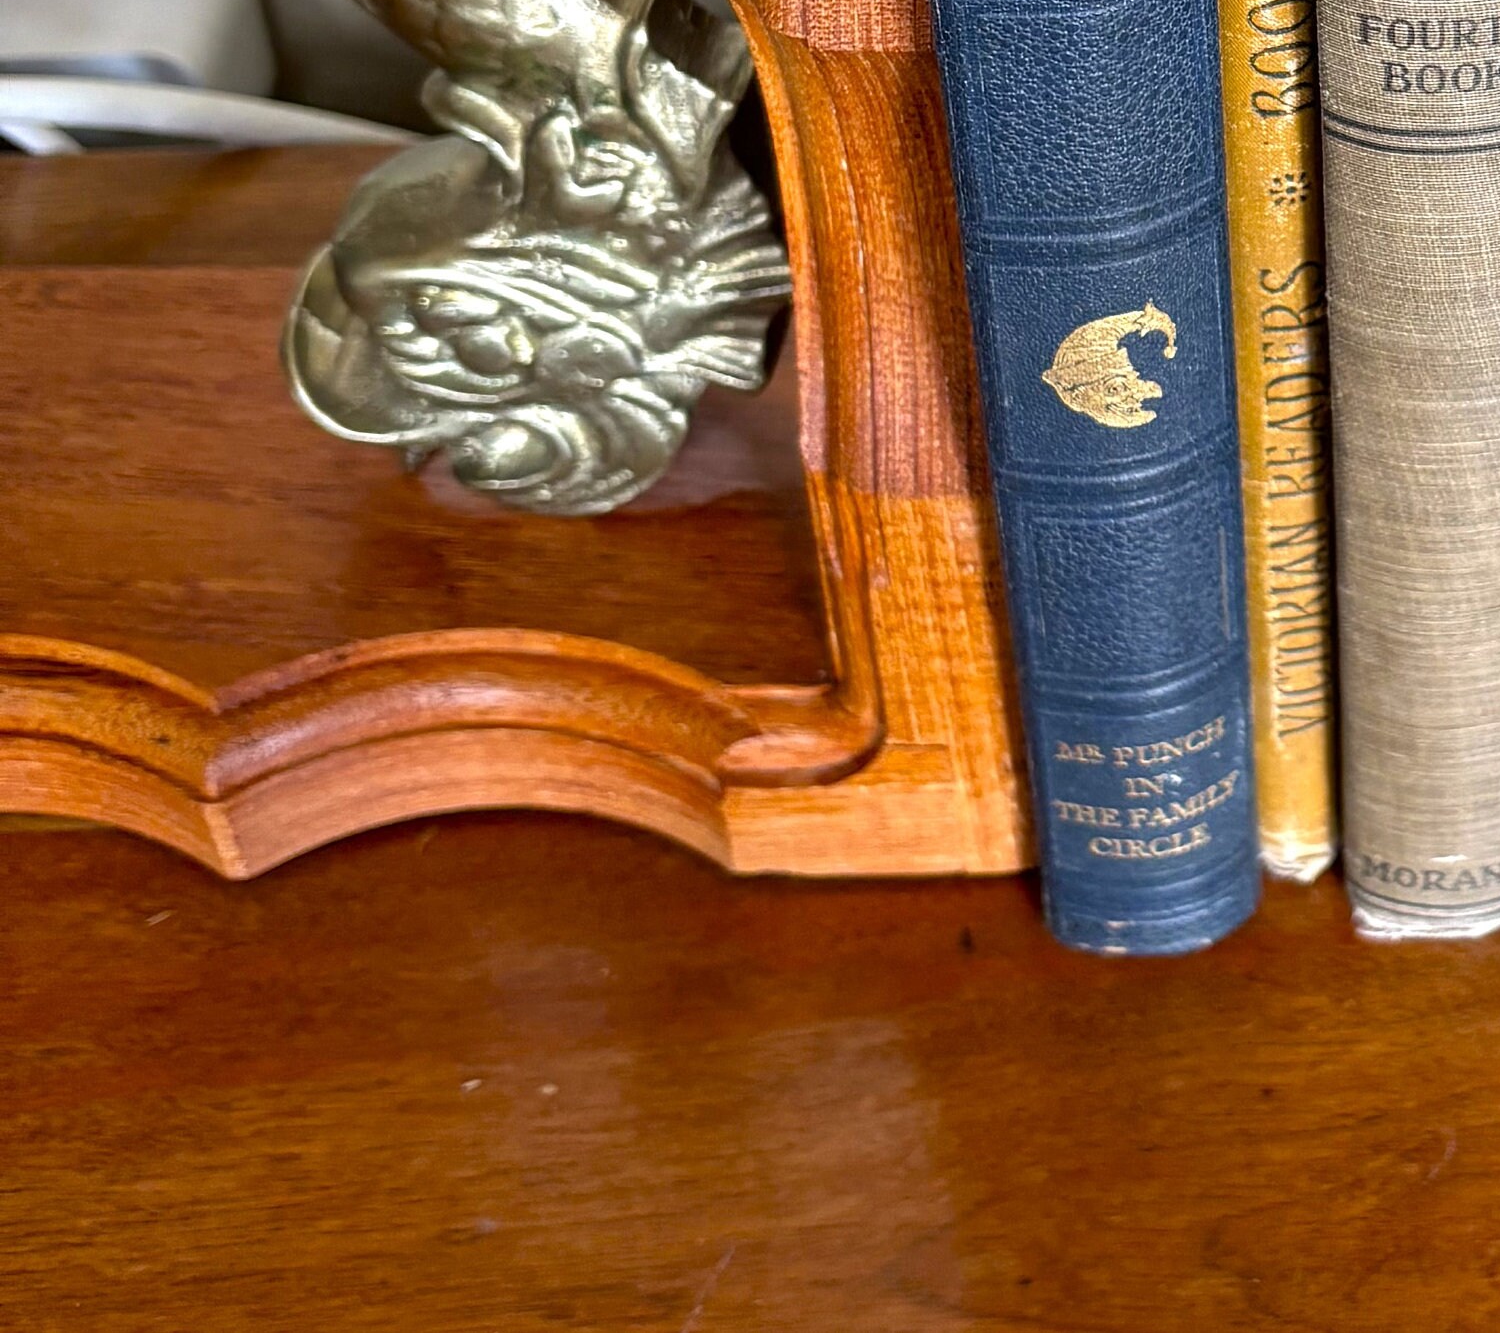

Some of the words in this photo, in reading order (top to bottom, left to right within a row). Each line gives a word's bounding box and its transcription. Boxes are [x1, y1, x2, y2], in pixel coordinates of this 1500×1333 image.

[1259, 260, 1330, 505] READERS
[1266, 517, 1331, 742] VICTORIAN
[1112, 716, 1225, 768] PUNCH
[1054, 800, 1122, 828] THE
[1127, 769, 1240, 829] FAMILY
[1124, 774, 1168, 798] IN
[1088, 823, 1212, 859] CIRCLE
